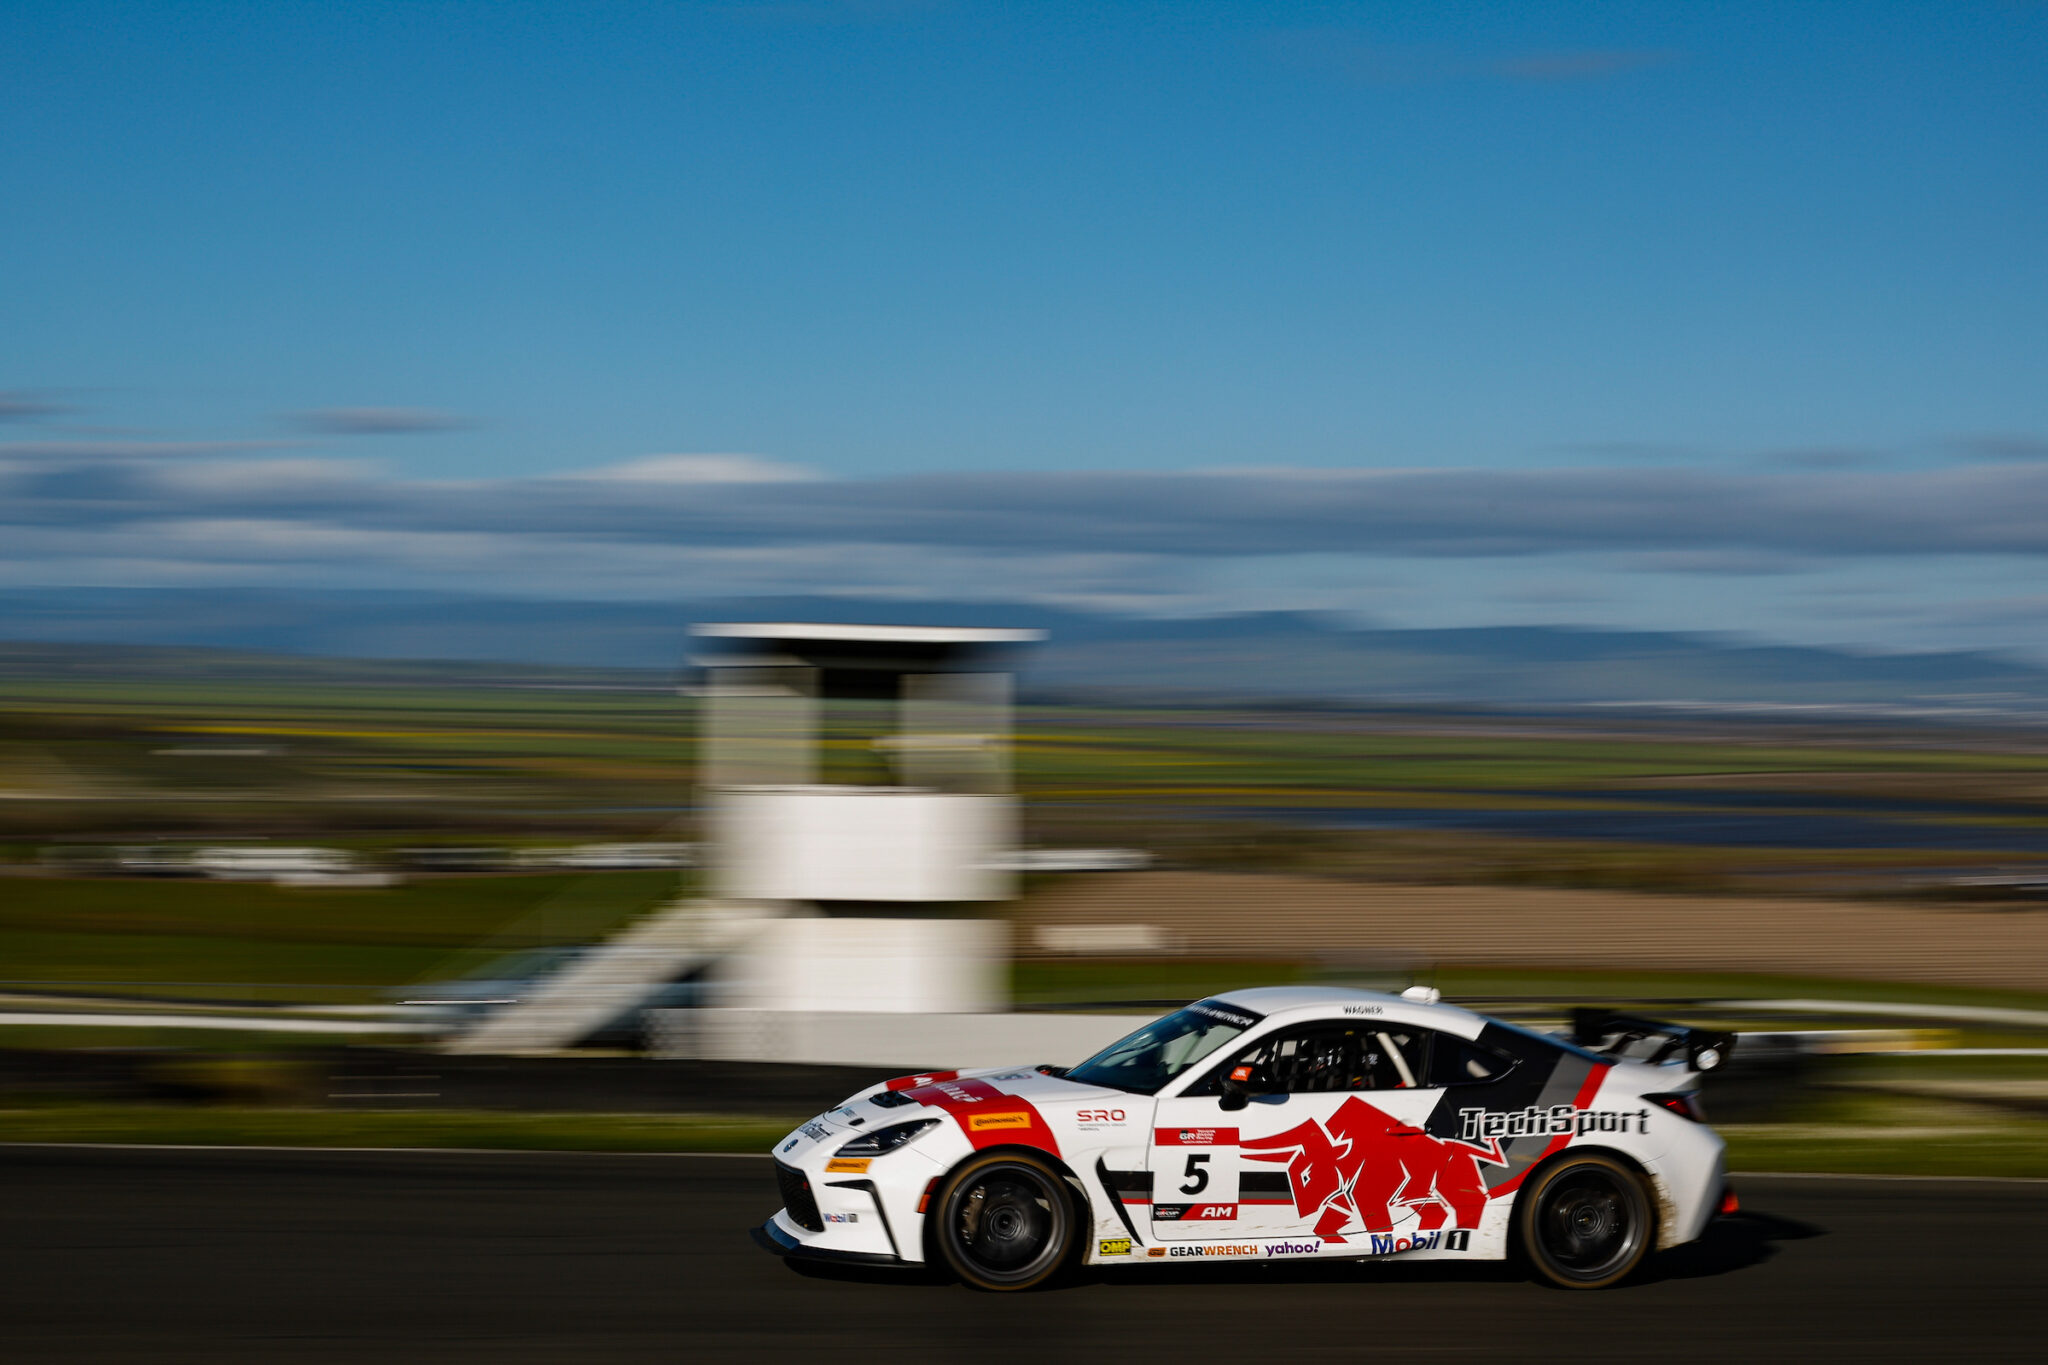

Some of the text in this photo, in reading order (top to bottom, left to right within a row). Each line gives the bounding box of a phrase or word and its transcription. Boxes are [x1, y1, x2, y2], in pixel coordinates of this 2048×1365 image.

[1077, 1109, 1125, 1121] SRO
[1459, 1104, 1651, 1140] TechSport
[1179, 1153, 1211, 1195] 5
[1200, 1206, 1232, 1218] AM
[1100, 1241, 1130, 1253] OMP
[1265, 1240, 1321, 1257] yahoo!
[1371, 1231, 1462, 1255] Mobil 1
[1170, 1245, 1258, 1257] GEARWRENCH
